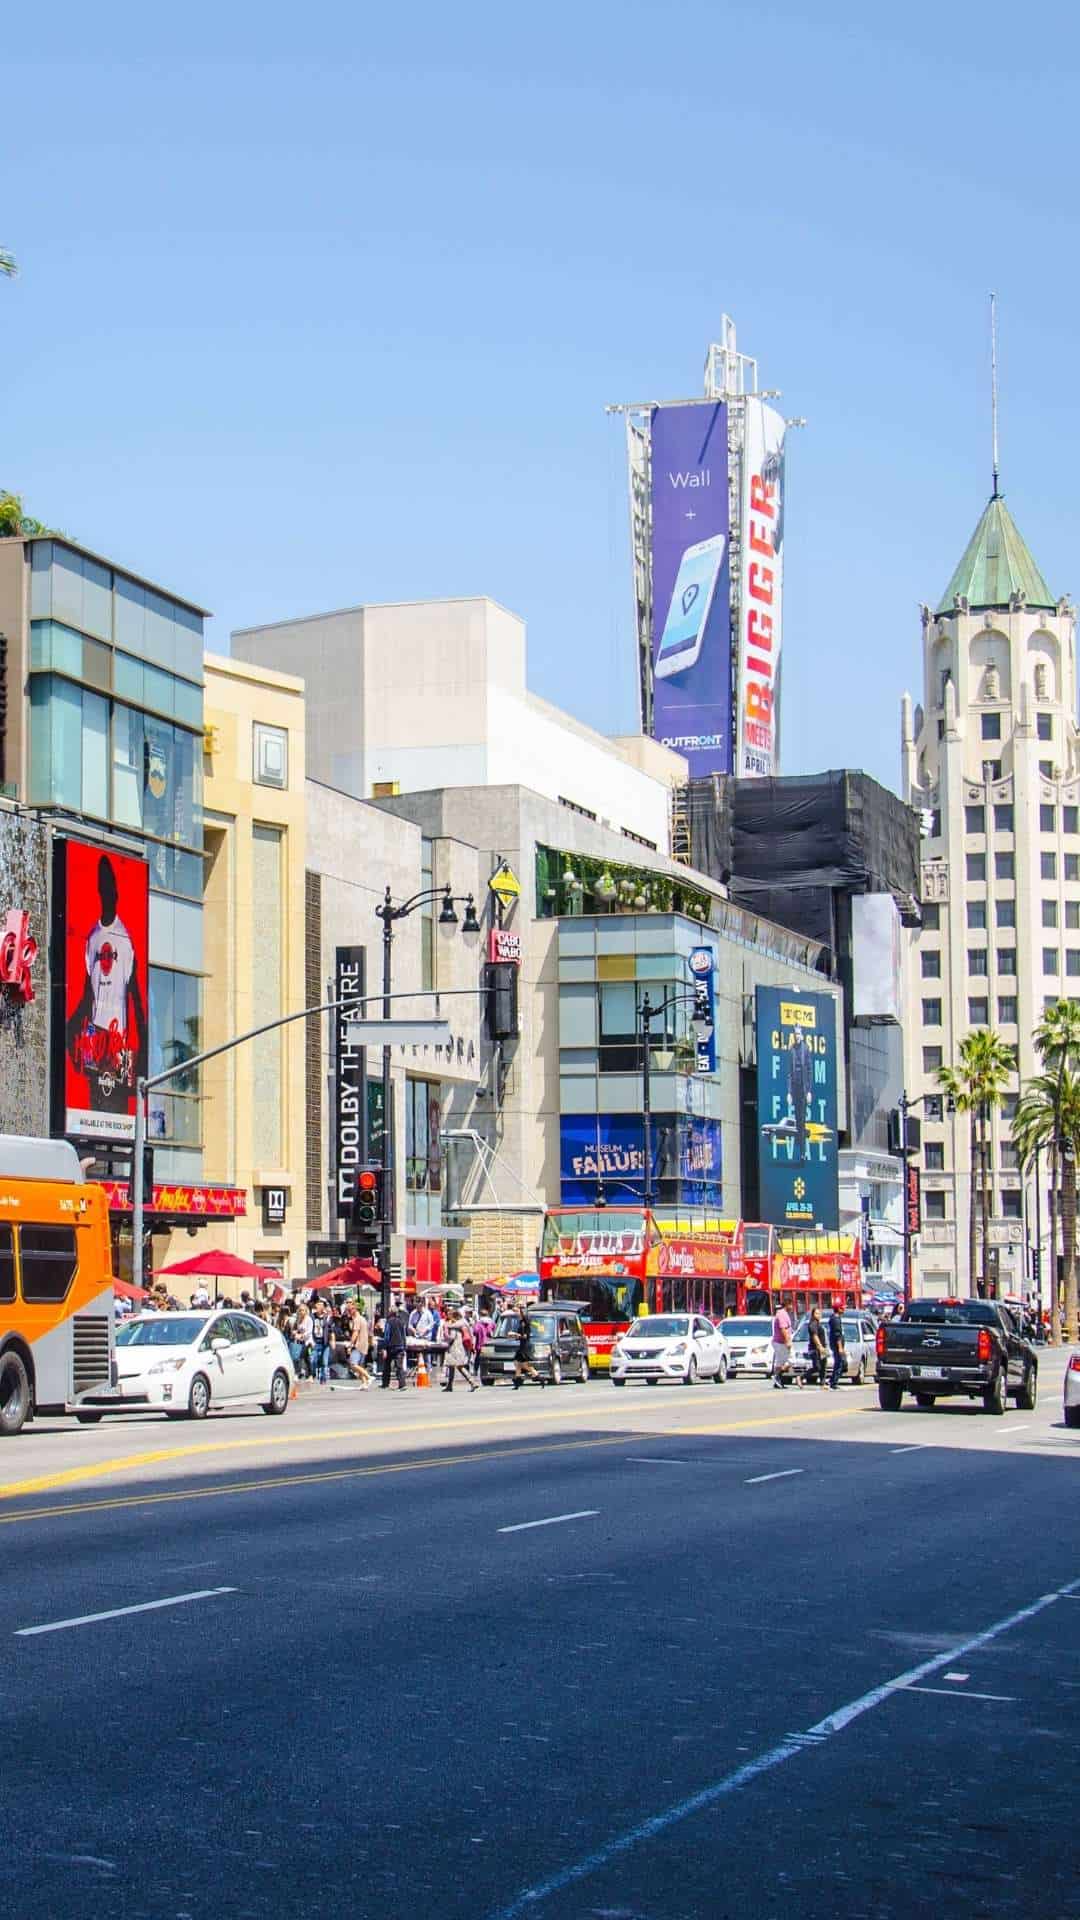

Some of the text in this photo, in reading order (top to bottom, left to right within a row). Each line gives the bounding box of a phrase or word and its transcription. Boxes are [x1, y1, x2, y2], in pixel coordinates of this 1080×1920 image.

[669, 470, 711, 489] Wall
[746, 474, 774, 726] BIGGER
[661, 734, 723, 747] OUTFRONT
[784, 1008, 813, 1023] TCM
[340, 962, 360, 1164] DOLBY THATRE
[697, 1055, 710, 1071] EAT
[771, 1055, 826, 1084] FM
[584, 1144, 623, 1153] MUSEUM
[572, 1150, 653, 1176] FAILUR
